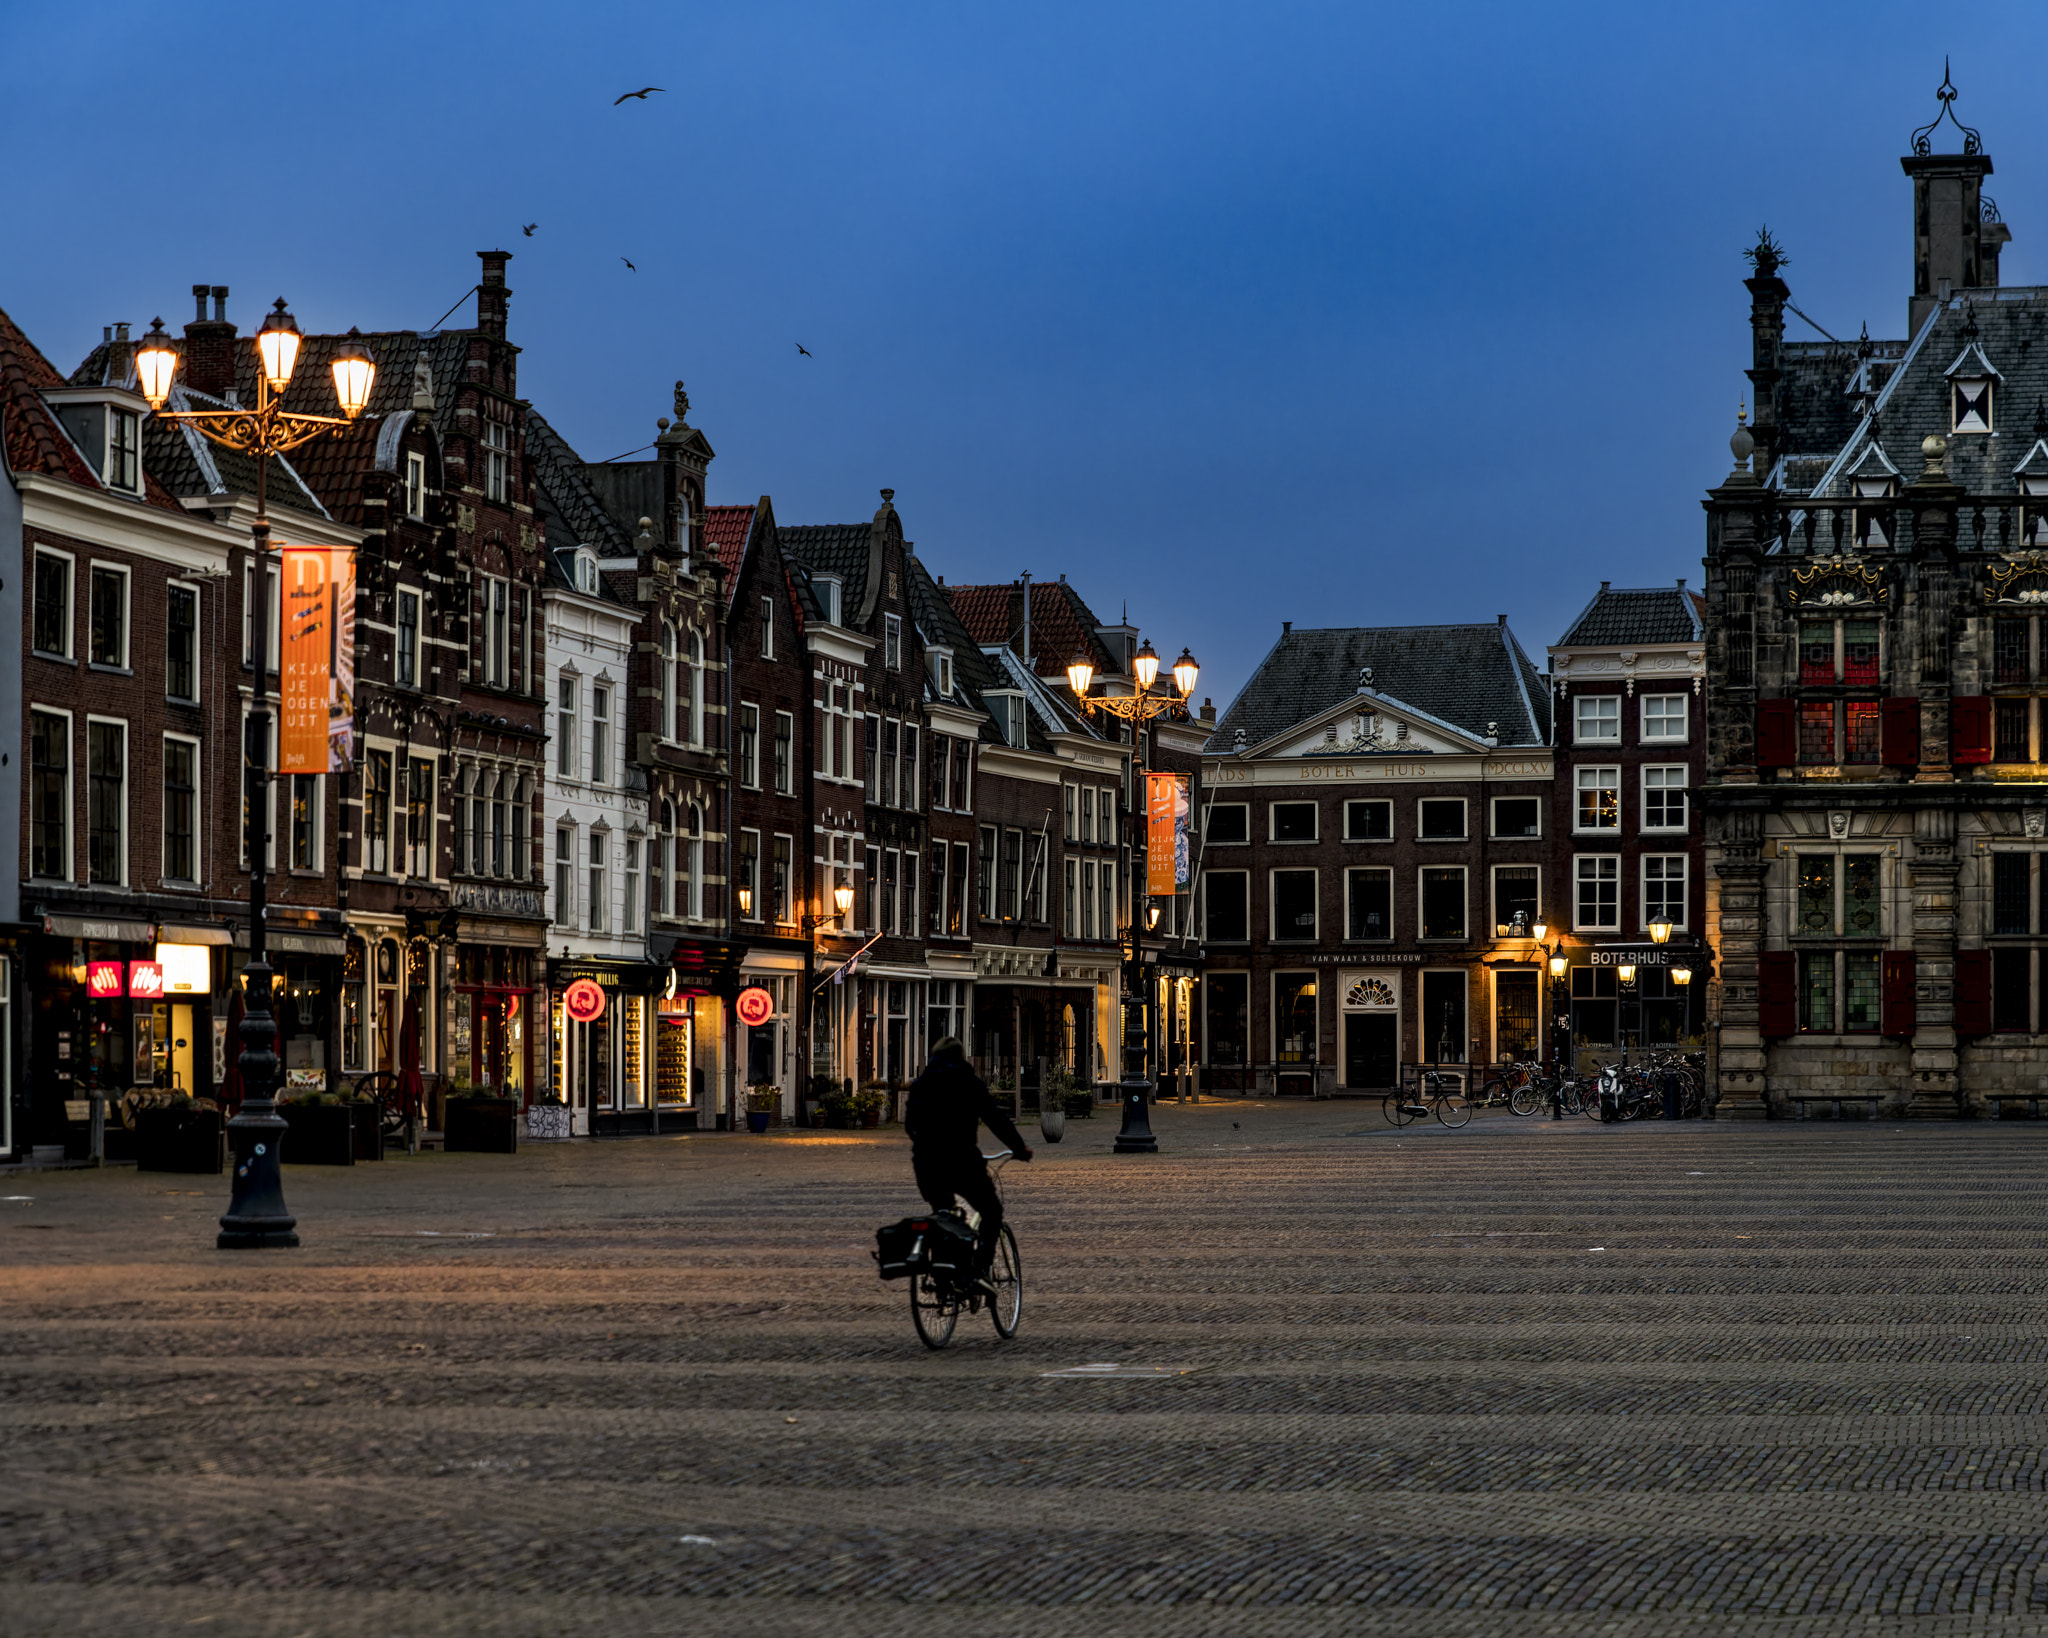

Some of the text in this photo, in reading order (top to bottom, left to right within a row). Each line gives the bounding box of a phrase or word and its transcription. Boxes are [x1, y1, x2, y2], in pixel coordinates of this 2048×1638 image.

[288, 662, 329, 675] KIJK
[288, 680, 307, 693] JE
[287, 697, 329, 710] OGEN
[287, 714, 318, 727] UIT
[1300, 764, 1355, 779] BOTER
[1487, 761, 1549, 775] MDCCLXV
[1151, 835, 1175, 844] KIJK
[1151, 845, 1162, 853] JE
[1151, 854, 1175, 862] OGEN
[1151, 863, 1168, 871] UIT
[1312, 954, 1421, 963] VAN WAAY & SOETEKOUW
[596, 972, 619, 986] WILLIG
